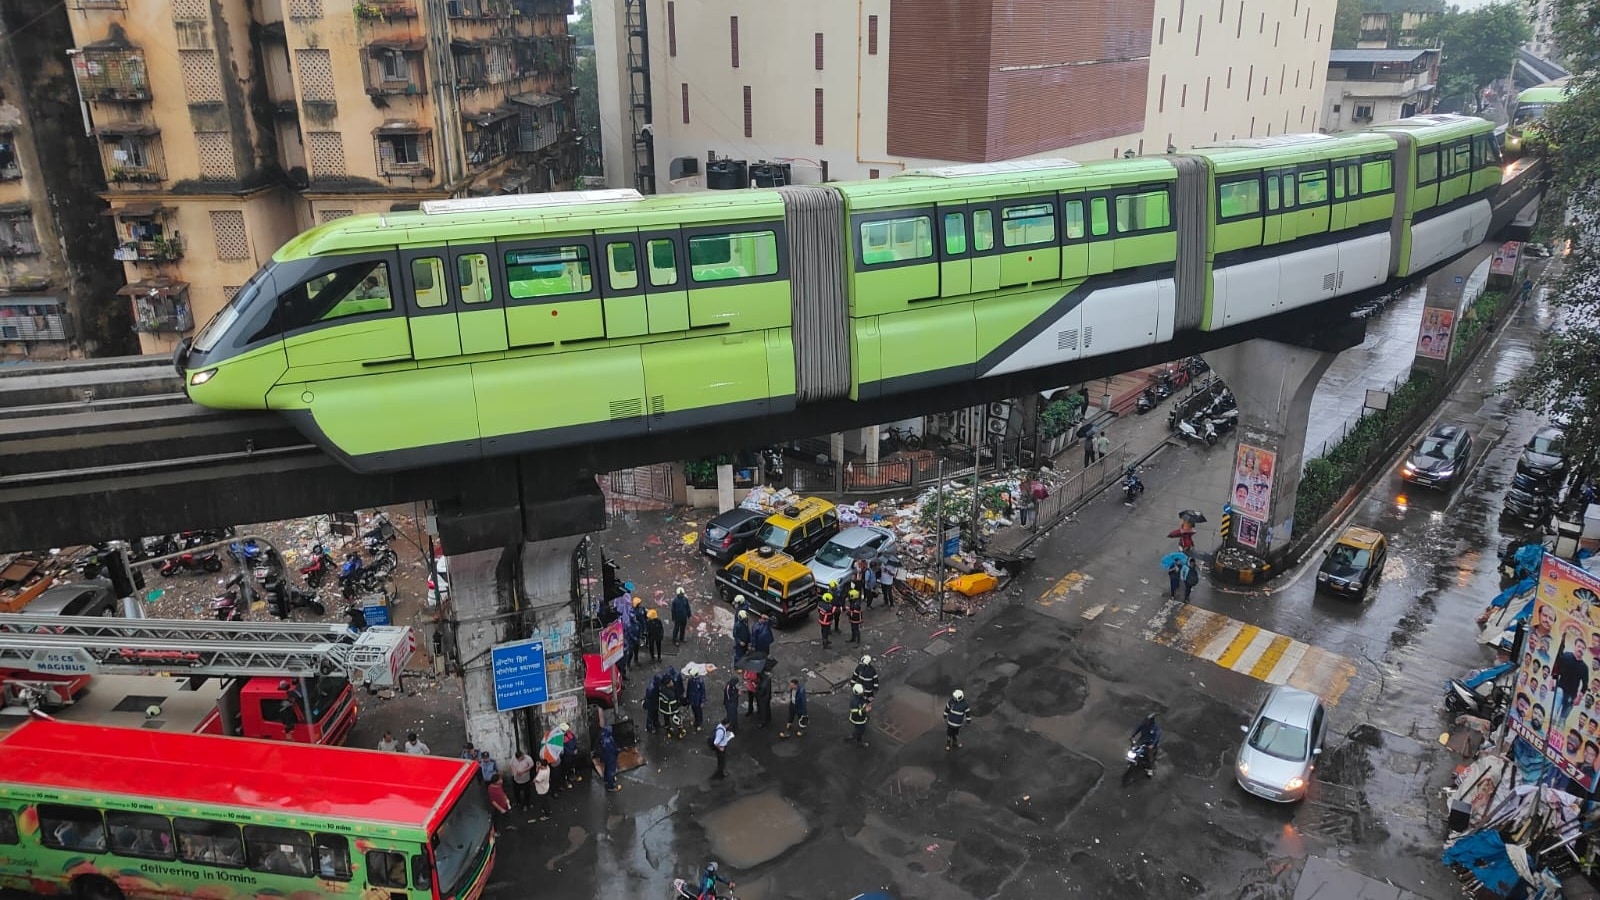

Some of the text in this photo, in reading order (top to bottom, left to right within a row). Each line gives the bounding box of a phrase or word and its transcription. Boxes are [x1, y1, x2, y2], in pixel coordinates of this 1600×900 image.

[37, 663, 86, 671] MAGIRUS
[523, 686, 543, 694] Station
[1512, 719, 1544, 750] KING
[1546, 747, 1564, 764] OF
[1566, 763, 1585, 781] 37
[140, 864, 258, 885] delivering in 10mins
